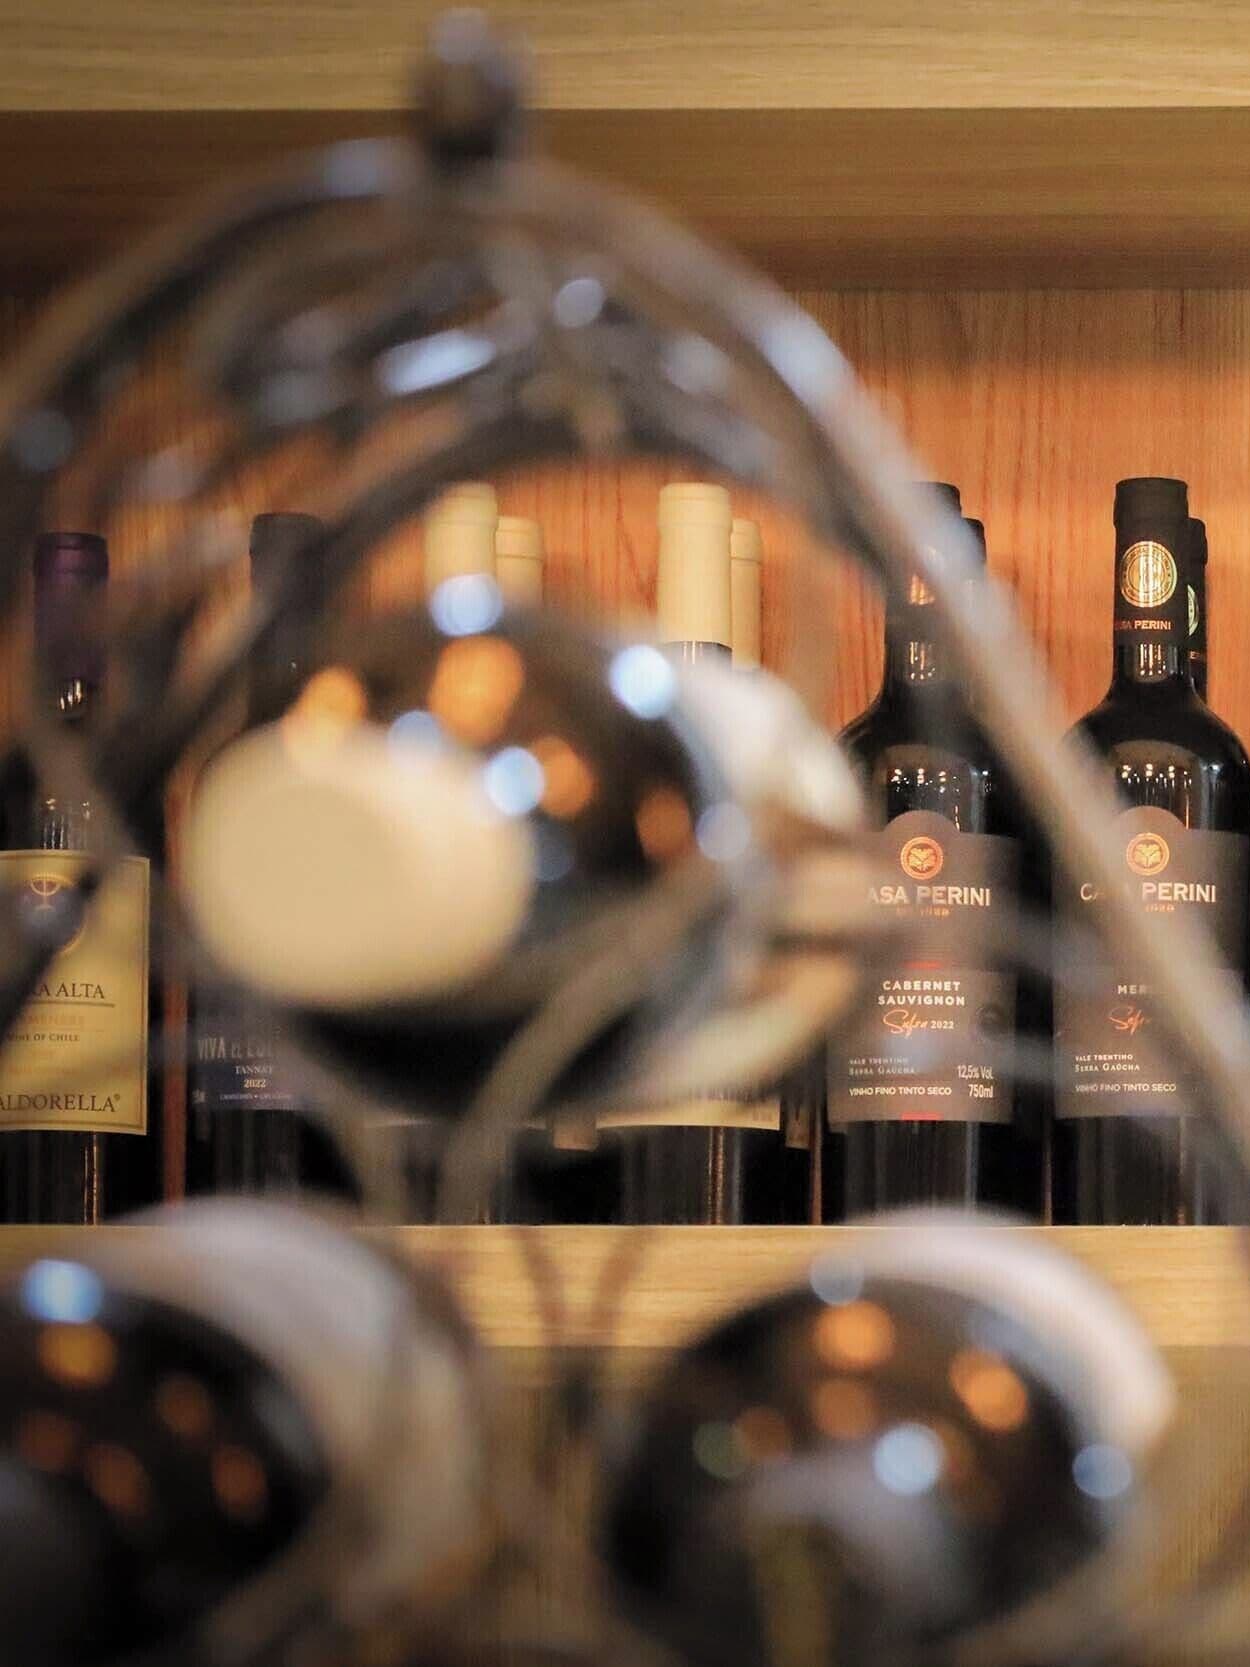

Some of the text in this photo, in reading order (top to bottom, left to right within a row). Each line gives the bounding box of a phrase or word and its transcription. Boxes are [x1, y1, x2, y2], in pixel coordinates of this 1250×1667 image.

[1134, 620, 1171, 630] PERINI
[865, 885, 991, 907] ASA PERINI
[1142, 882, 1216, 903] PERINI
[56, 982, 105, 999] ALTA
[882, 980, 961, 992] CABERNET
[878, 995, 965, 1006] SAUVIGNON
[930, 1020, 955, 1030] 2022
[1094, 1053, 1134, 1062] TRENTINO
[243, 1079, 267, 1089] 2022
[1099, 1083, 1121, 1093] FINO
[1122, 1083, 1149, 1092] TINTO
[1151, 1083, 1177, 1092] SECO
[849, 1085, 952, 1097] VINHO FINO TINTO SECO
[968, 1083, 994, 1099] 750ml
